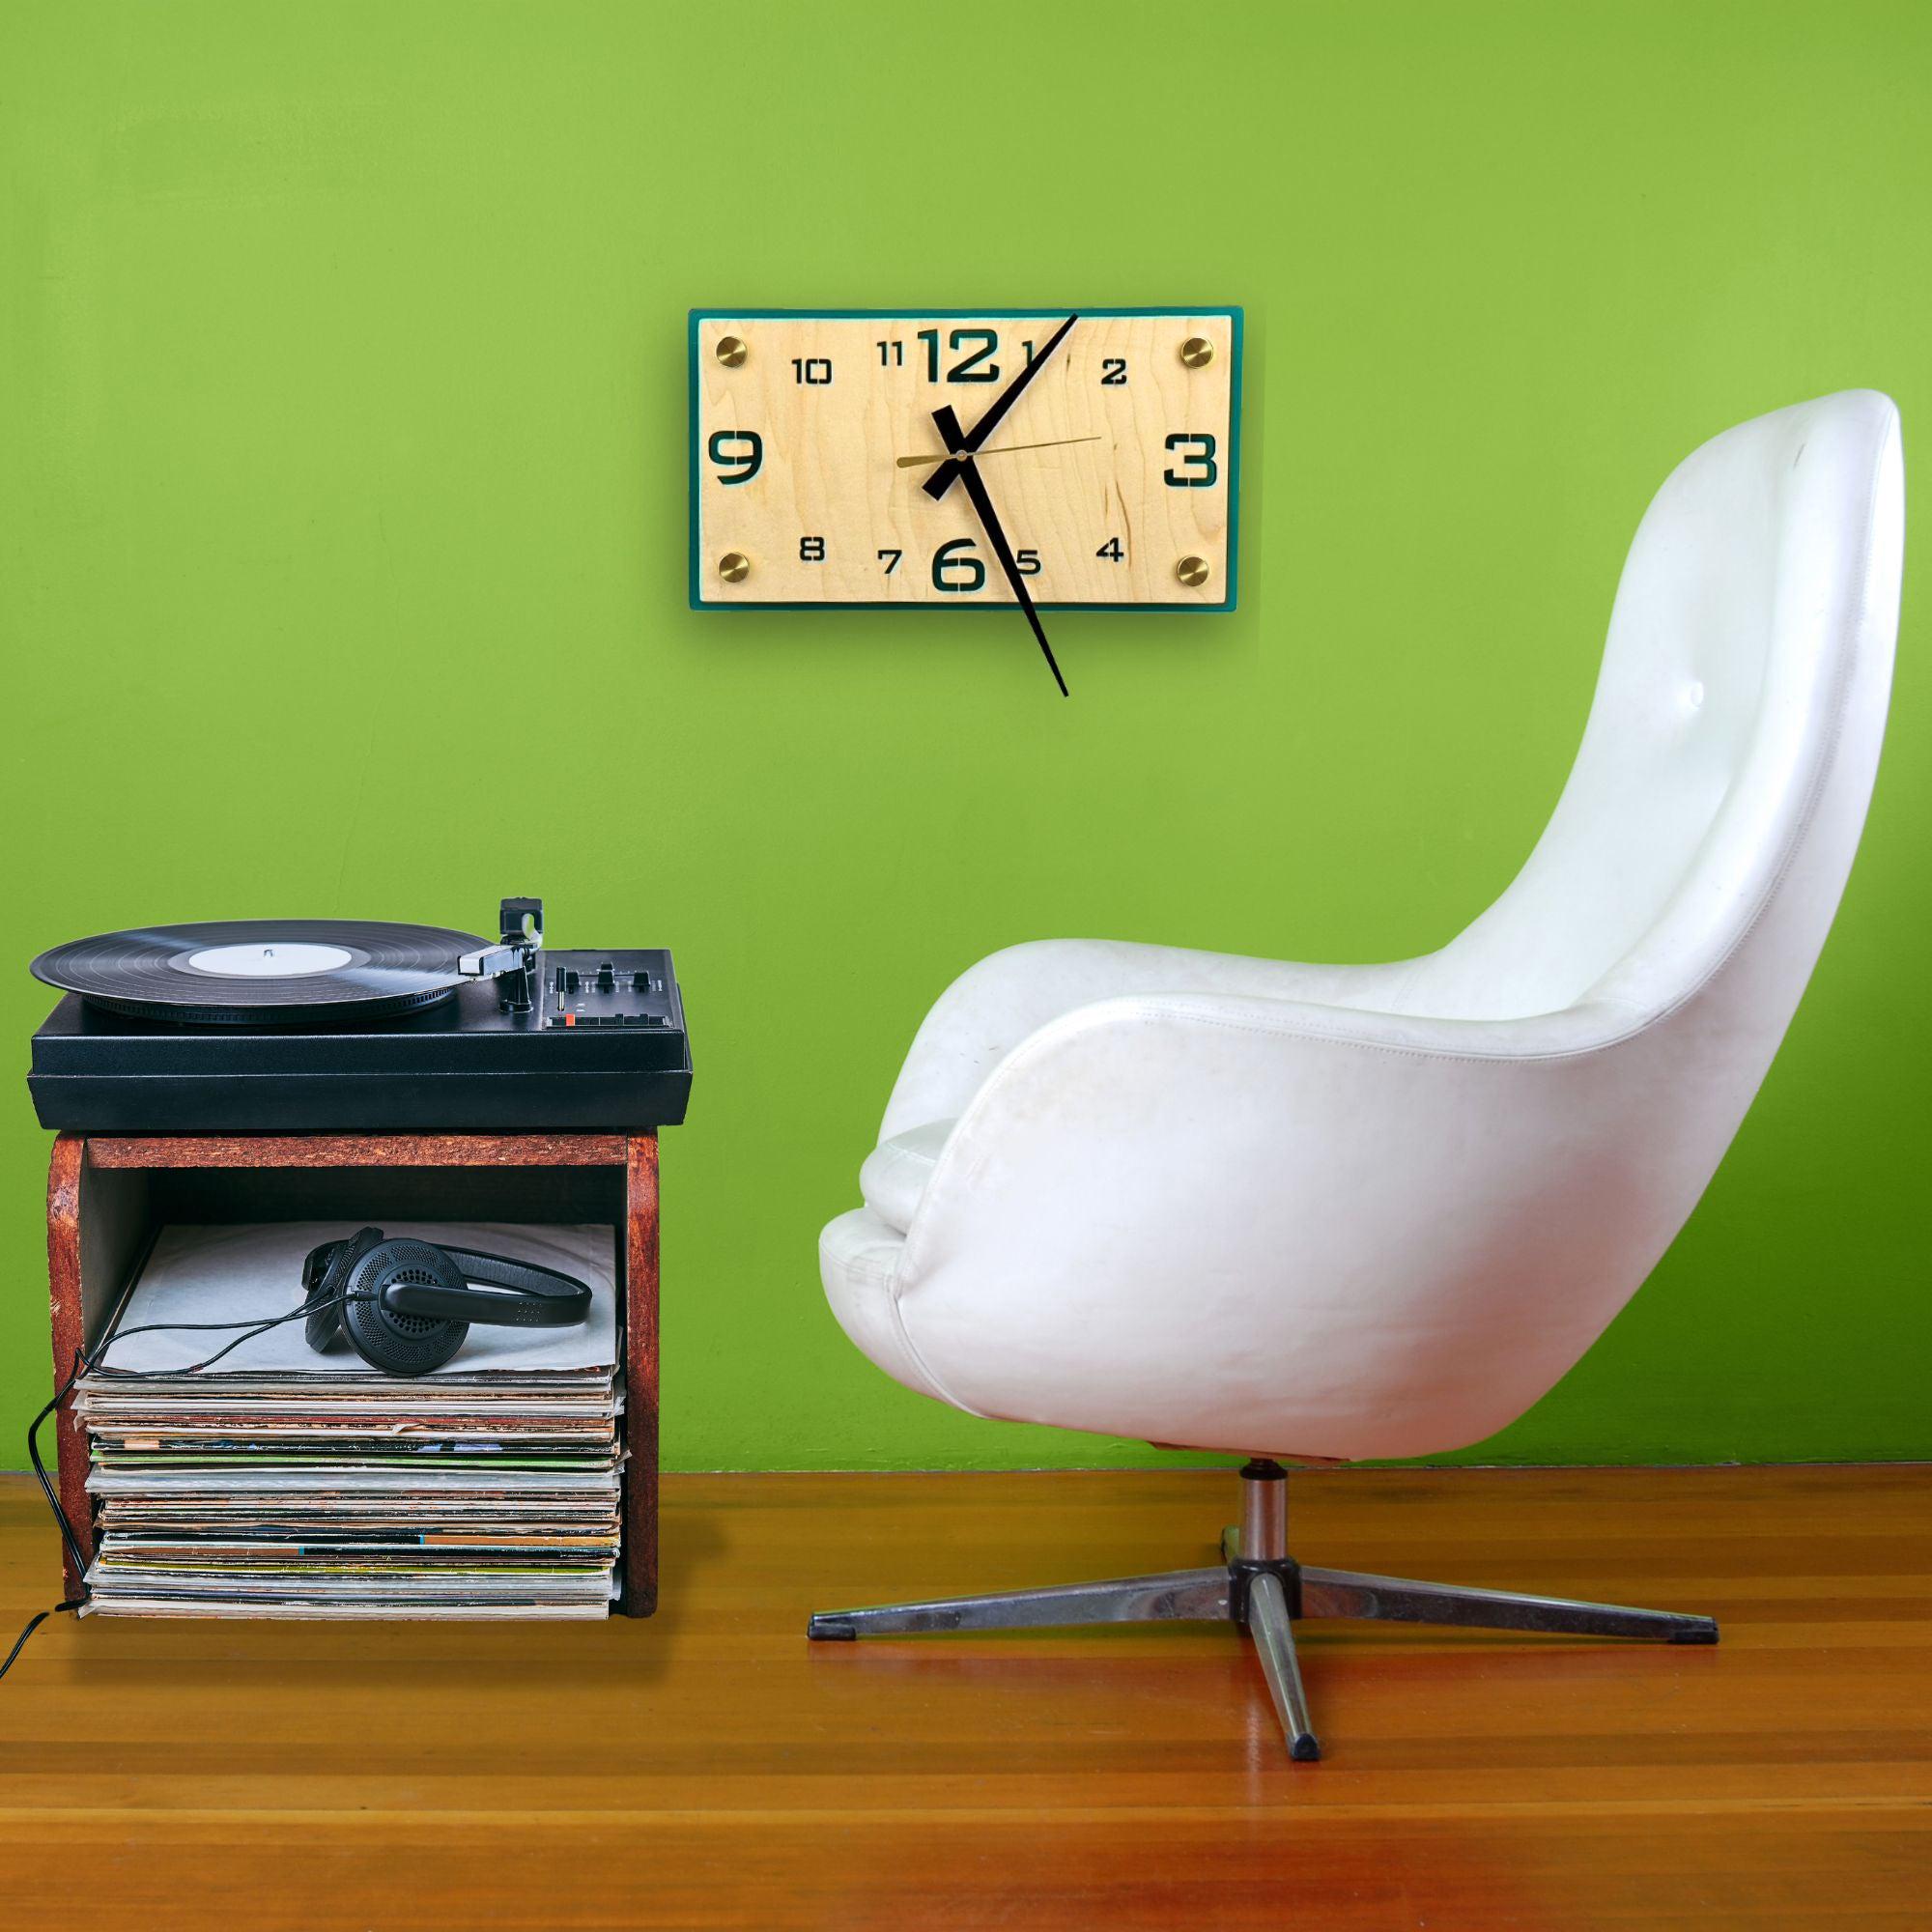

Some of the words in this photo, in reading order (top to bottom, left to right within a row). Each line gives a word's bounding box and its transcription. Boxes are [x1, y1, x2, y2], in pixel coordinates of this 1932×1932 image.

[877, 341, 902, 366] 11
[918, 328, 999, 383] 12
[1022, 340, 1033, 367] 1
[791, 358, 833, 384] 10
[1101, 358, 1127, 385] 2
[708, 431, 763, 485] 9
[1164, 434, 1217, 488] 3
[800, 537, 825, 561] 8
[1096, 537, 1124, 562] 4
[878, 550, 902, 575] 7
[932, 538, 985, 592] 6
[1016, 550, 1041, 575] 5
